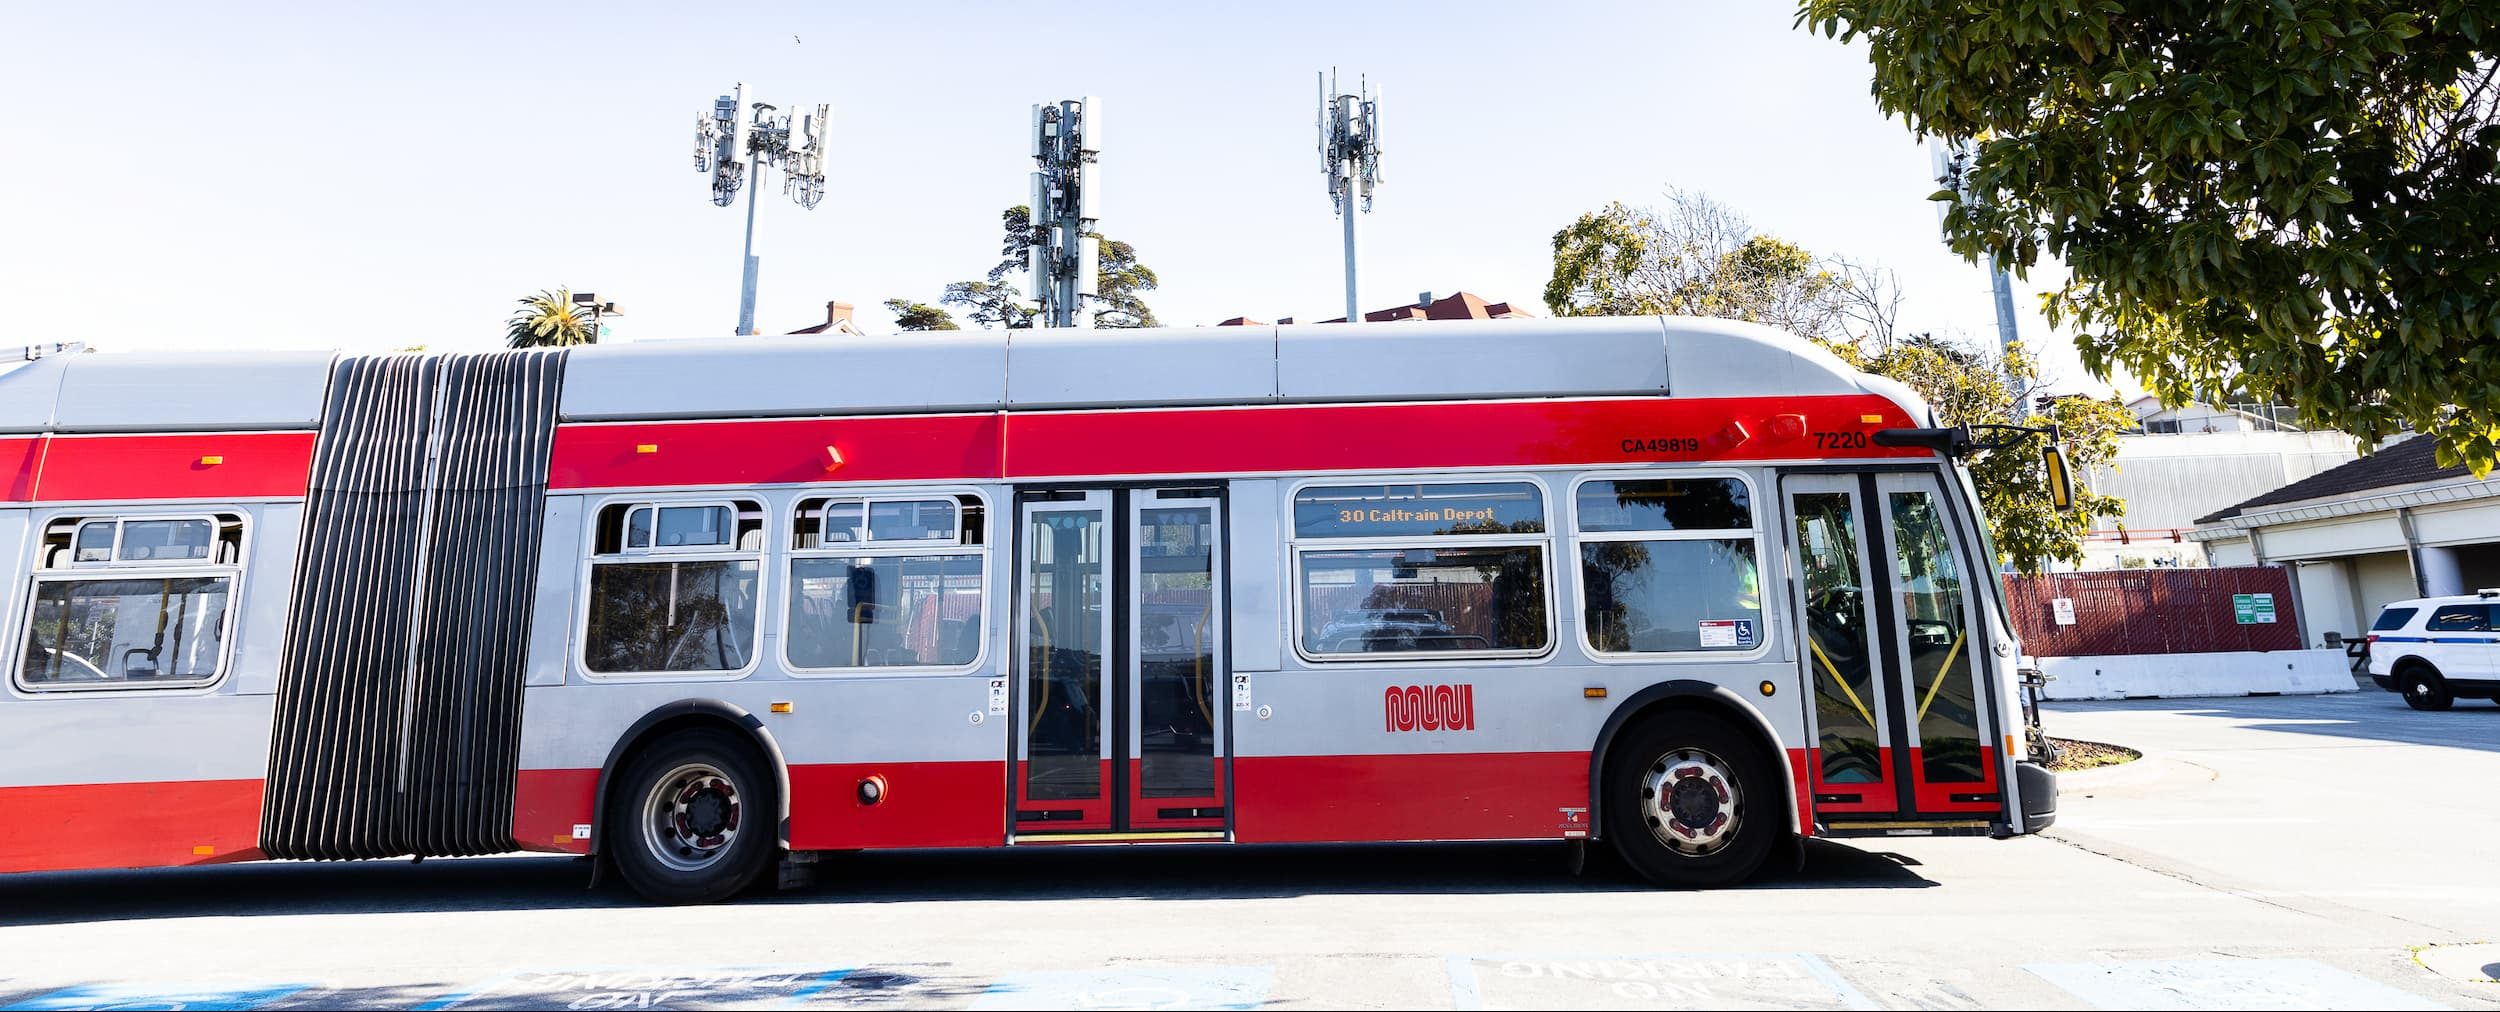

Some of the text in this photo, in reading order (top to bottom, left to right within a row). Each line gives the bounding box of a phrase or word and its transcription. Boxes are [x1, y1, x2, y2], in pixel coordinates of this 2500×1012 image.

[1621, 437, 1699, 453] CA49819
[1813, 431, 1867, 449] 7220
[1340, 507, 1494, 523] 30 Caltrain Depot
